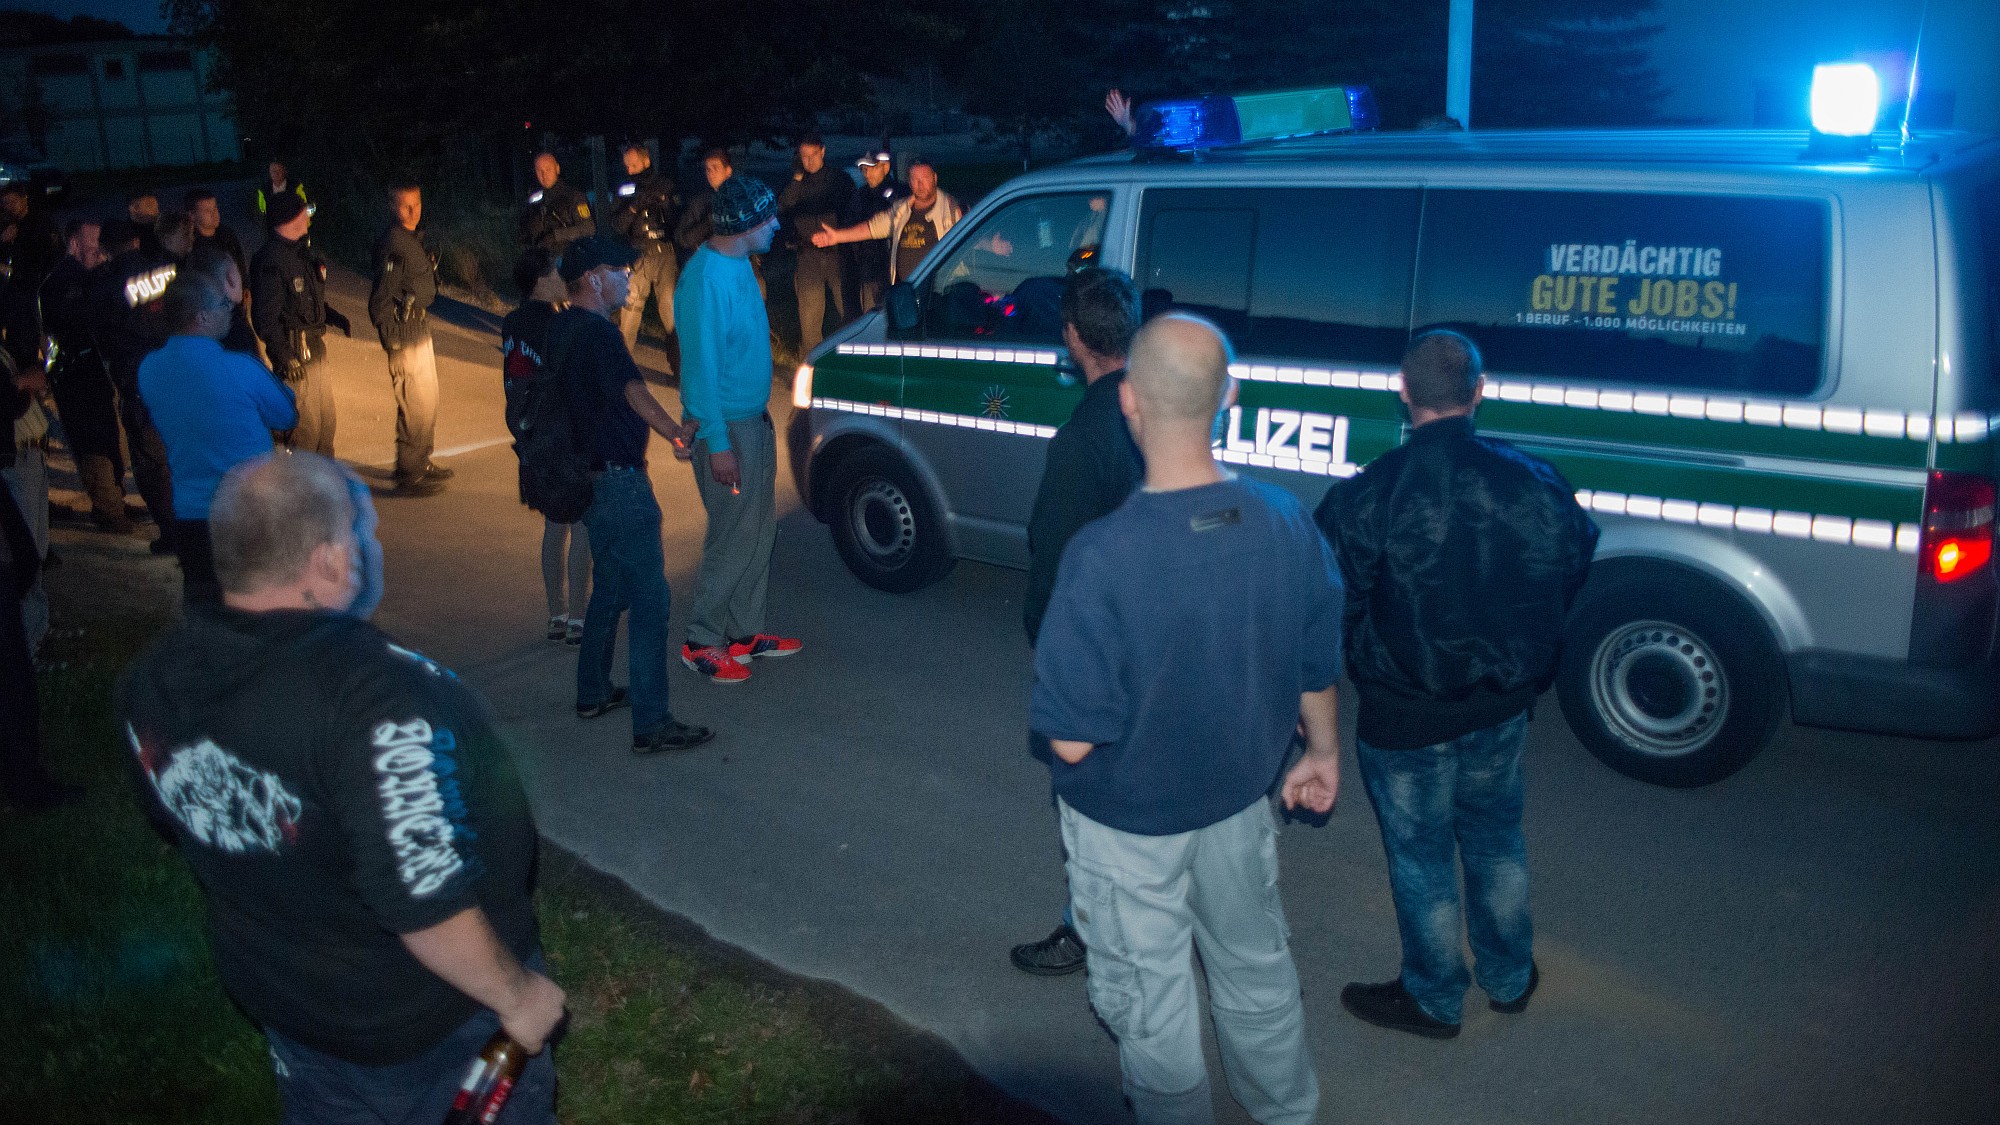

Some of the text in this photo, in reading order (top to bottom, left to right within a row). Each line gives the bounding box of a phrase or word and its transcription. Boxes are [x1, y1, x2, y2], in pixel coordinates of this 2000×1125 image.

[1549, 239, 1723, 277] VERDÄCHTIG
[1531, 274, 1738, 320] GUTE JOBS!
[1525, 312, 1570, 326] BERUF
[1583, 315, 1622, 329] 1.000
[1625, 316, 1747, 336] MÖGLICHKEITEN
[1211, 405, 1350, 464] LIZEI
